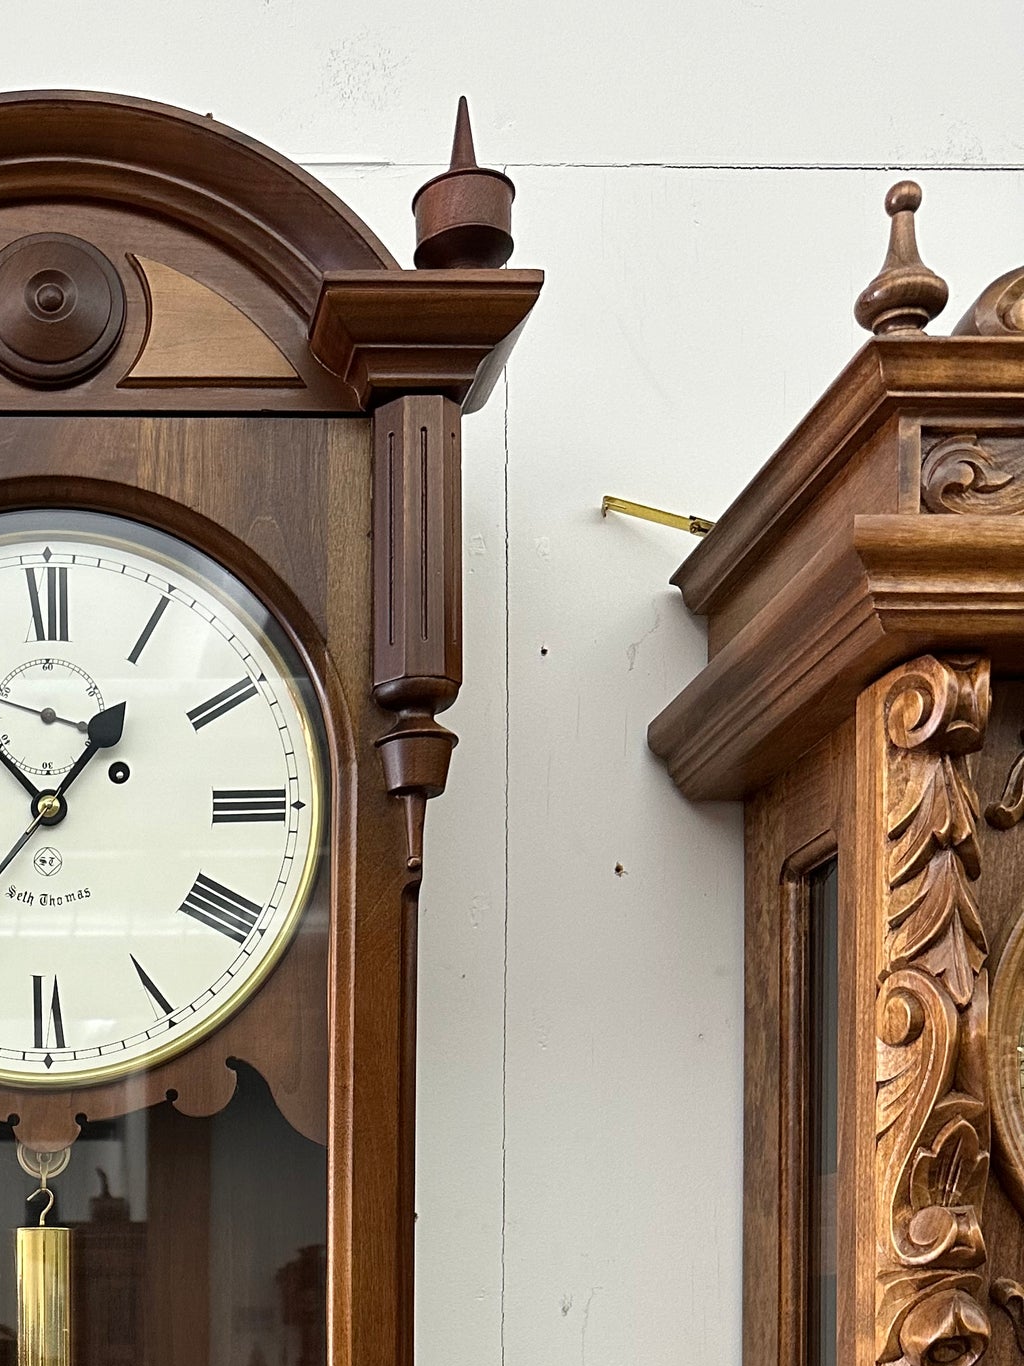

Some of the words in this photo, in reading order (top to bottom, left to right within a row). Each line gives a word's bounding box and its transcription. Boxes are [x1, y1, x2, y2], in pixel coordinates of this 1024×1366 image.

[24, 566, 73, 643] XII
[126, 594, 172, 664] I
[1, 687, 11, 699] 50
[42, 663, 54, 671] 60
[85, 686, 95, 697] 10
[186, 673, 260, 733] II
[212, 787, 287, 824] III
[5, 884, 35, 907] Seth
[39, 887, 91, 907] Thomas
[179, 872, 265, 946] IIII
[30, 973, 70, 1049] VI
[130, 953, 179, 1021] V
